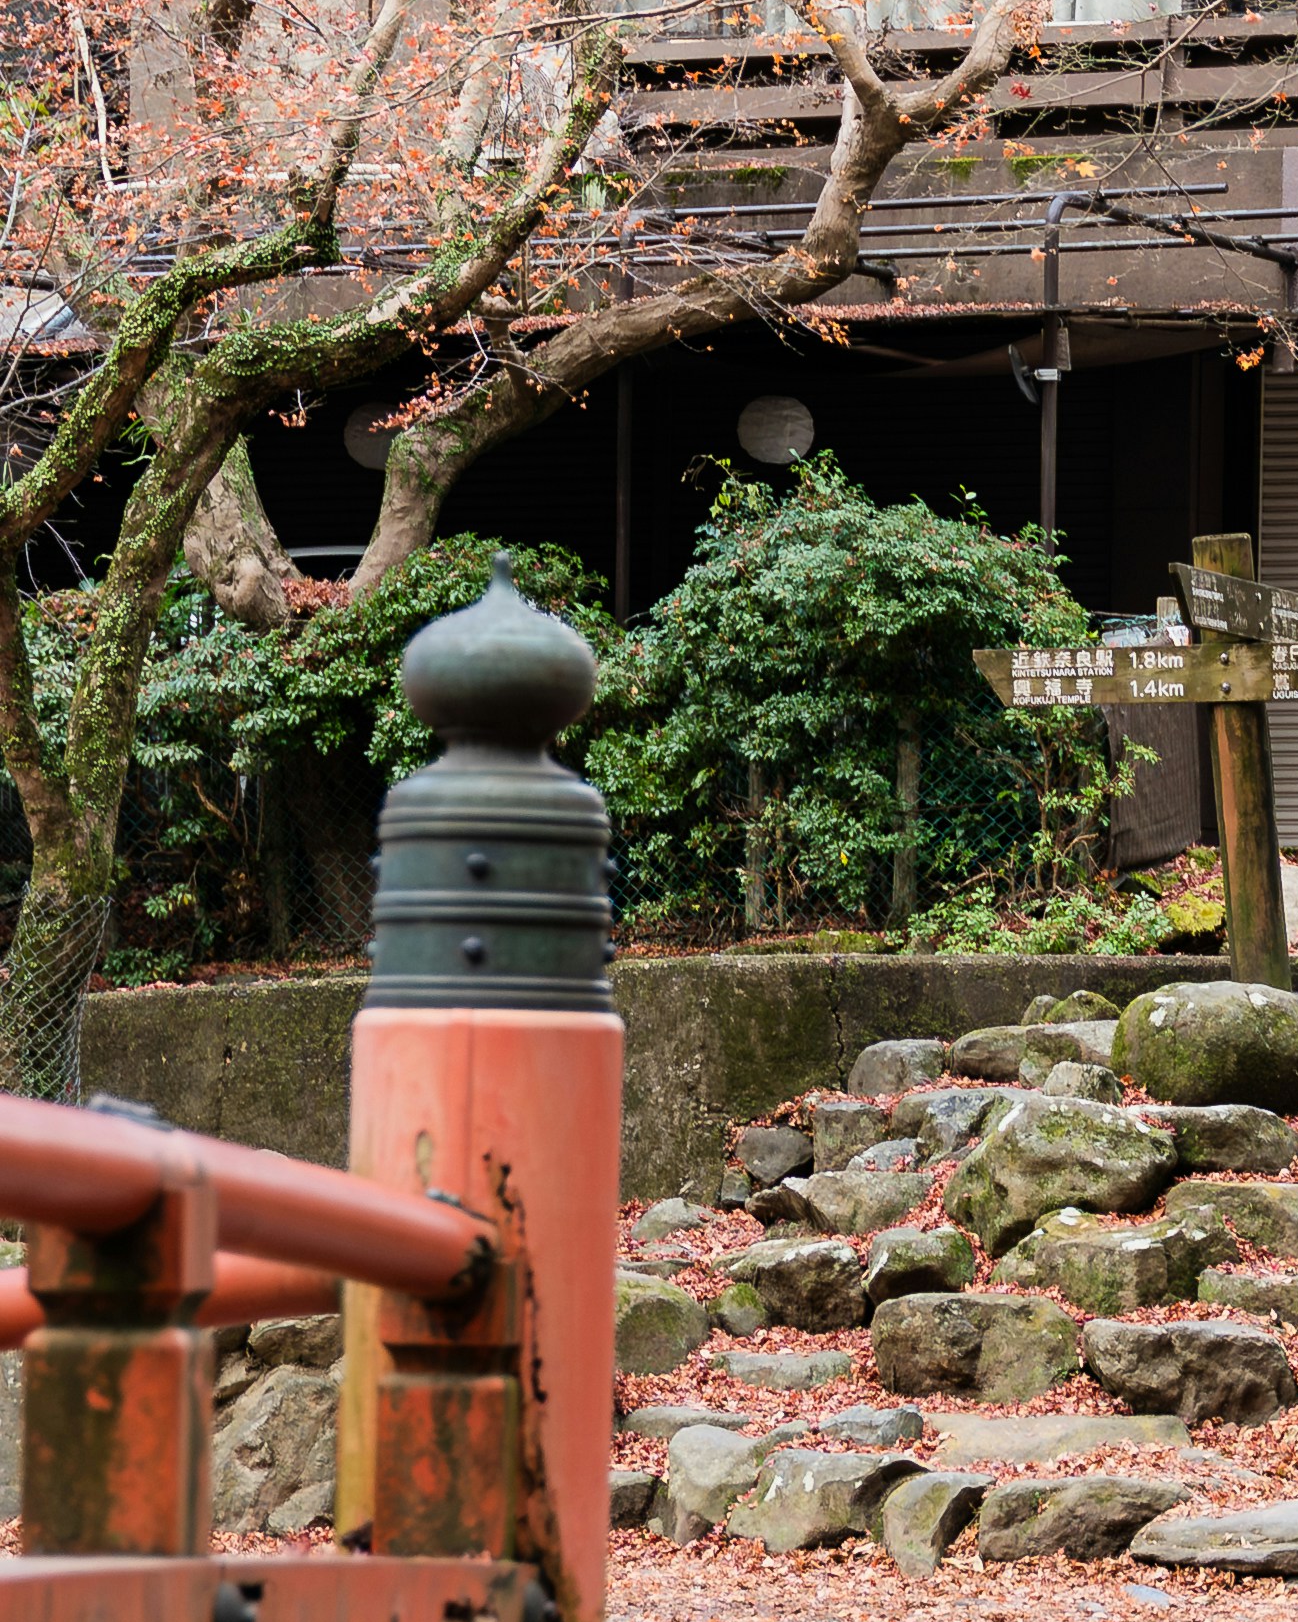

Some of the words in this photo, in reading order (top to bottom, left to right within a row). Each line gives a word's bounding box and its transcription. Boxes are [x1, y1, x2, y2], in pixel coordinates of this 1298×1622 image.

[1011, 649, 1114, 669] 近鉄奈良駅
[1129, 651, 1184, 669] 1.8km
[1012, 668, 1052, 678] KINTETSU
[1053, 668, 1077, 677] NARA
[1077, 667, 1113, 676] STATION
[1013, 678, 1094, 697] 興福寺
[1129, 679, 1184, 697] 1.4km
[1012, 696, 1055, 705] KOFUKUJI
[1056, 695, 1091, 704] TEMPLE
